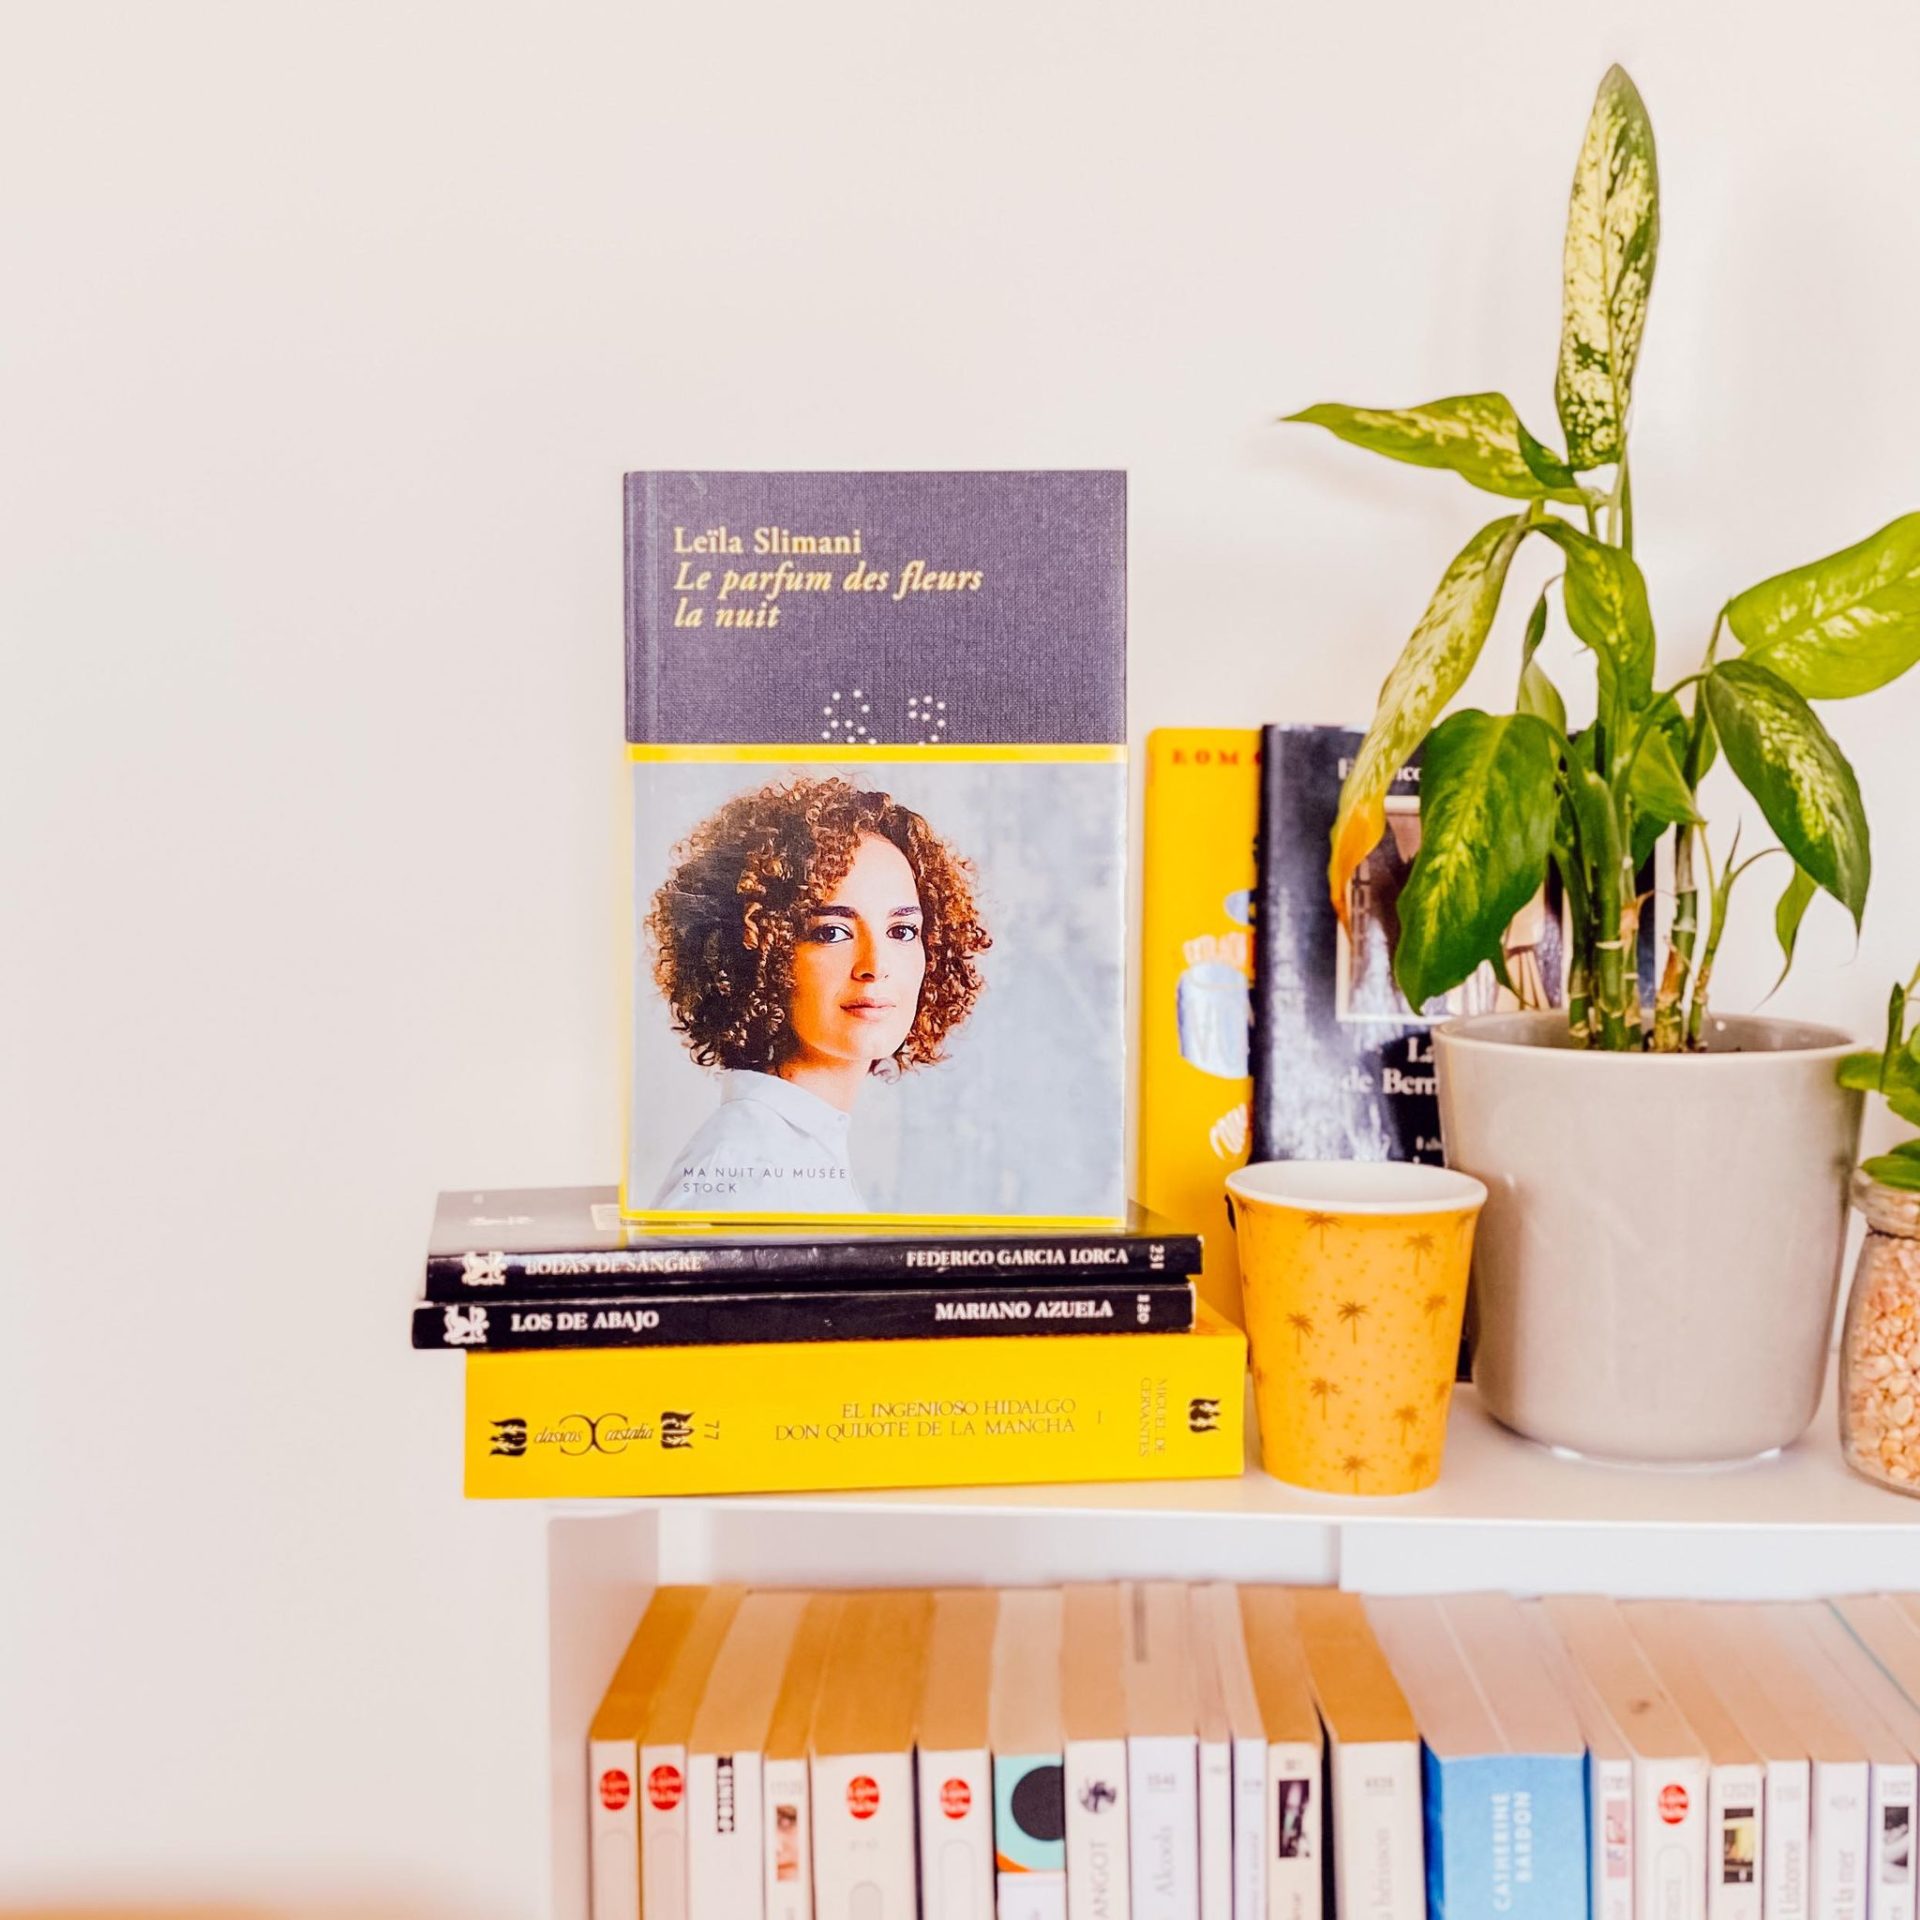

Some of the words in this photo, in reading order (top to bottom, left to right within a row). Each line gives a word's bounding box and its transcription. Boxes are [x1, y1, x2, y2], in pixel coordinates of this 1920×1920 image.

[674, 527, 743, 553] Leïla
[754, 527, 862, 553] Slimani
[674, 561, 711, 590] Le
[718, 561, 832, 600] parfum
[843, 561, 889, 591] des
[892, 560, 983, 600] fleurs
[674, 597, 702, 627] la
[715, 603, 780, 627] nuit
[683, 1167, 706, 1177] MA
[716, 1167, 753, 1177] NUIT
[763, 1168, 784, 1178] AU
[793, 1166, 847, 1179] MUSÉE
[683, 1183, 737, 1193] STOCK
[526, 1258, 590, 1274] BODAS
[629, 1255, 702, 1272] SANGRE
[906, 1250, 994, 1267] FEDERICO
[997, 1248, 1066, 1265] GARCIA
[1070, 1246, 1129, 1264] LORCA
[1149, 1244, 1165, 1269] 231
[511, 1313, 552, 1331] LOS
[557, 1312, 588, 1330] DE
[593, 1310, 659, 1332] ABAJO
[935, 1302, 1030, 1320] MARIANO
[1035, 1300, 1113, 1317] AZUELA
[1136, 1294, 1151, 1325] 120
[842, 1404, 864, 1418] EL
[871, 1401, 978, 1417] INGENIOSO
[984, 1399, 1076, 1414] HIDALGO
[1139, 1377, 1151, 1457] CERVANTES
[1155, 1379, 1167, 1431] MIGUEL
[704, 1419, 720, 1440] 77
[775, 1424, 820, 1441] DON
[826, 1421, 909, 1443] QUIJOTE
[917, 1421, 942, 1436] DE
[951, 1420, 975, 1435] LA
[985, 1418, 1075, 1435] MANCHA
[1155, 1438, 1166, 1455] DE
[1513, 1791, 1533, 1883] BARDON
[1492, 1792, 1511, 1910] CATHERINE
